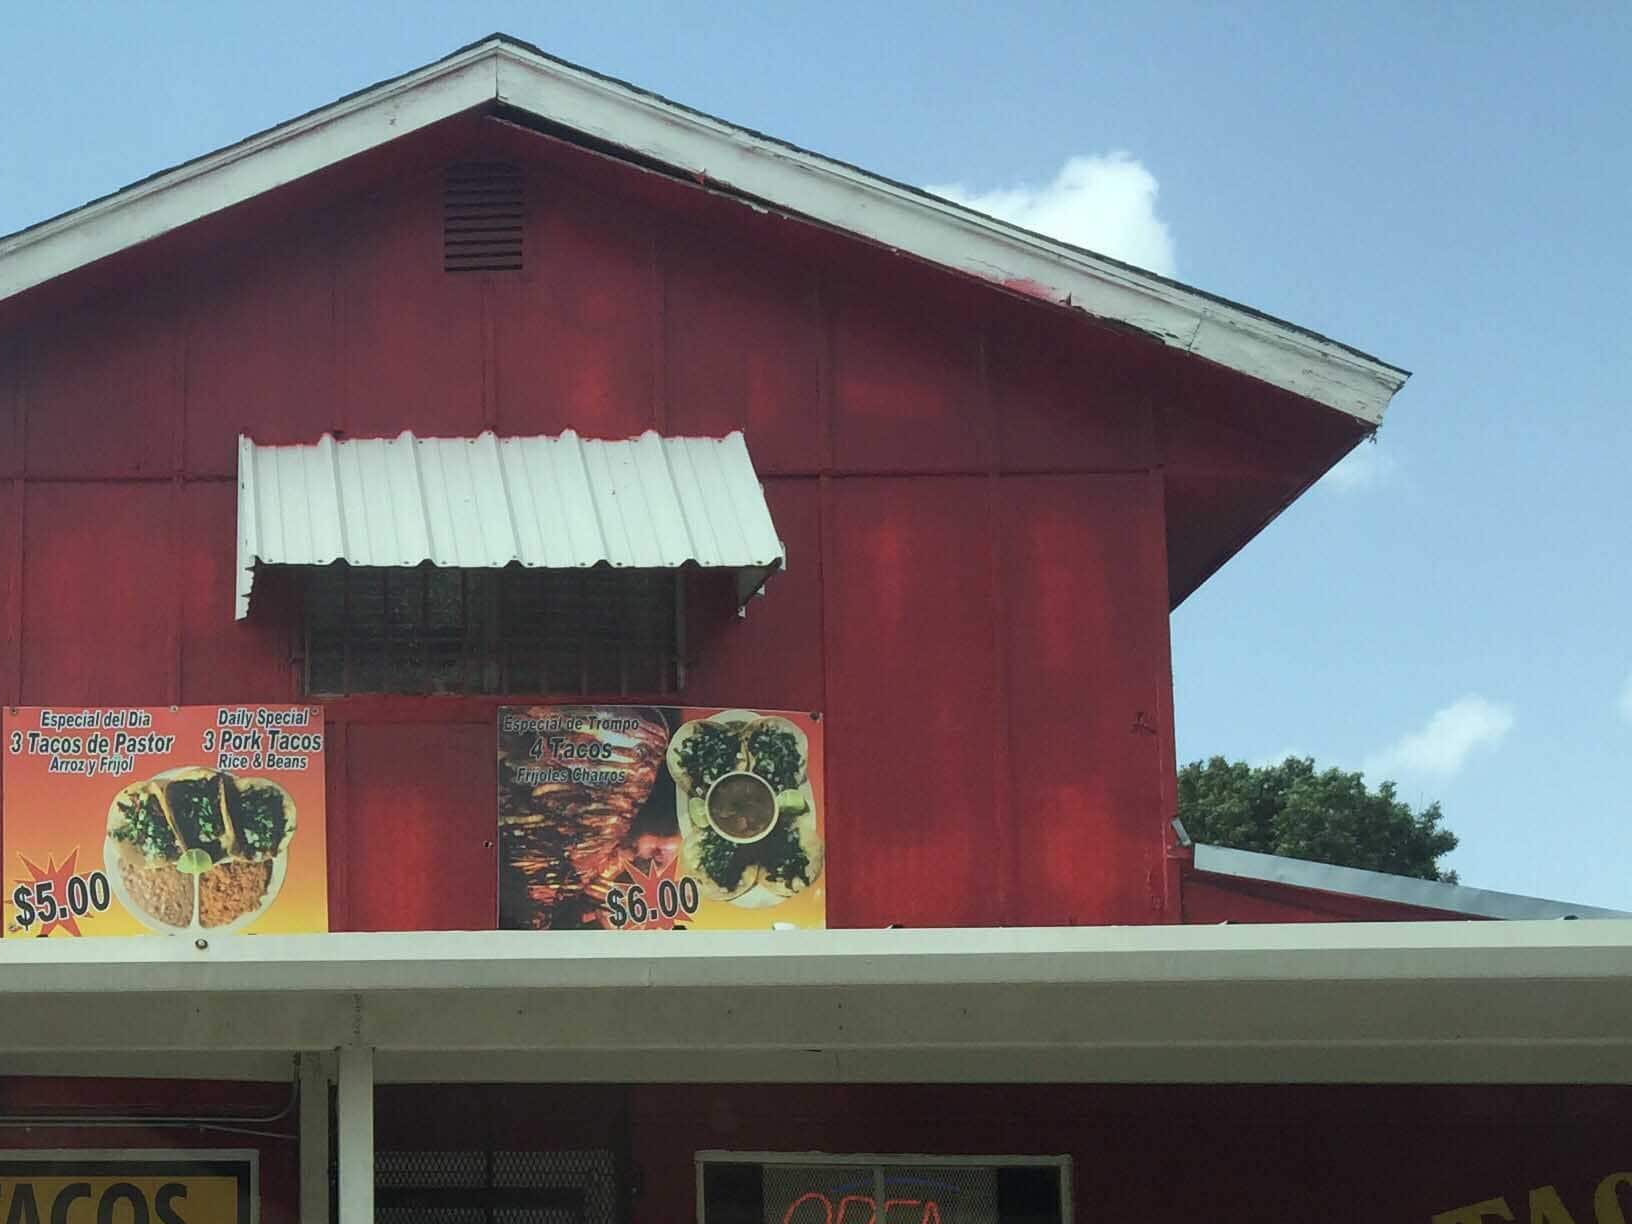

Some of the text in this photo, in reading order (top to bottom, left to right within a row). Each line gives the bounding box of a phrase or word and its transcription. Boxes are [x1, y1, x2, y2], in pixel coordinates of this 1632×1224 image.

[40, 711, 152, 729] Especial del Dia
[218, 709, 309, 728] Daily Special
[504, 715, 640, 734] Especial de Trompo
[11, 732, 174, 754] 3 Tacos de Pastor
[203, 730, 322, 751] 3 Pork Tacos
[529, 736, 613, 760] 4 Tacos
[49, 756, 133, 776] Arroz y Frijol
[218, 753, 307, 770] Rice & Beans
[517, 767, 625, 785] Frijoles Charros
[13, 872, 111, 931] $5.00
[606, 877, 700, 927] $6.00
